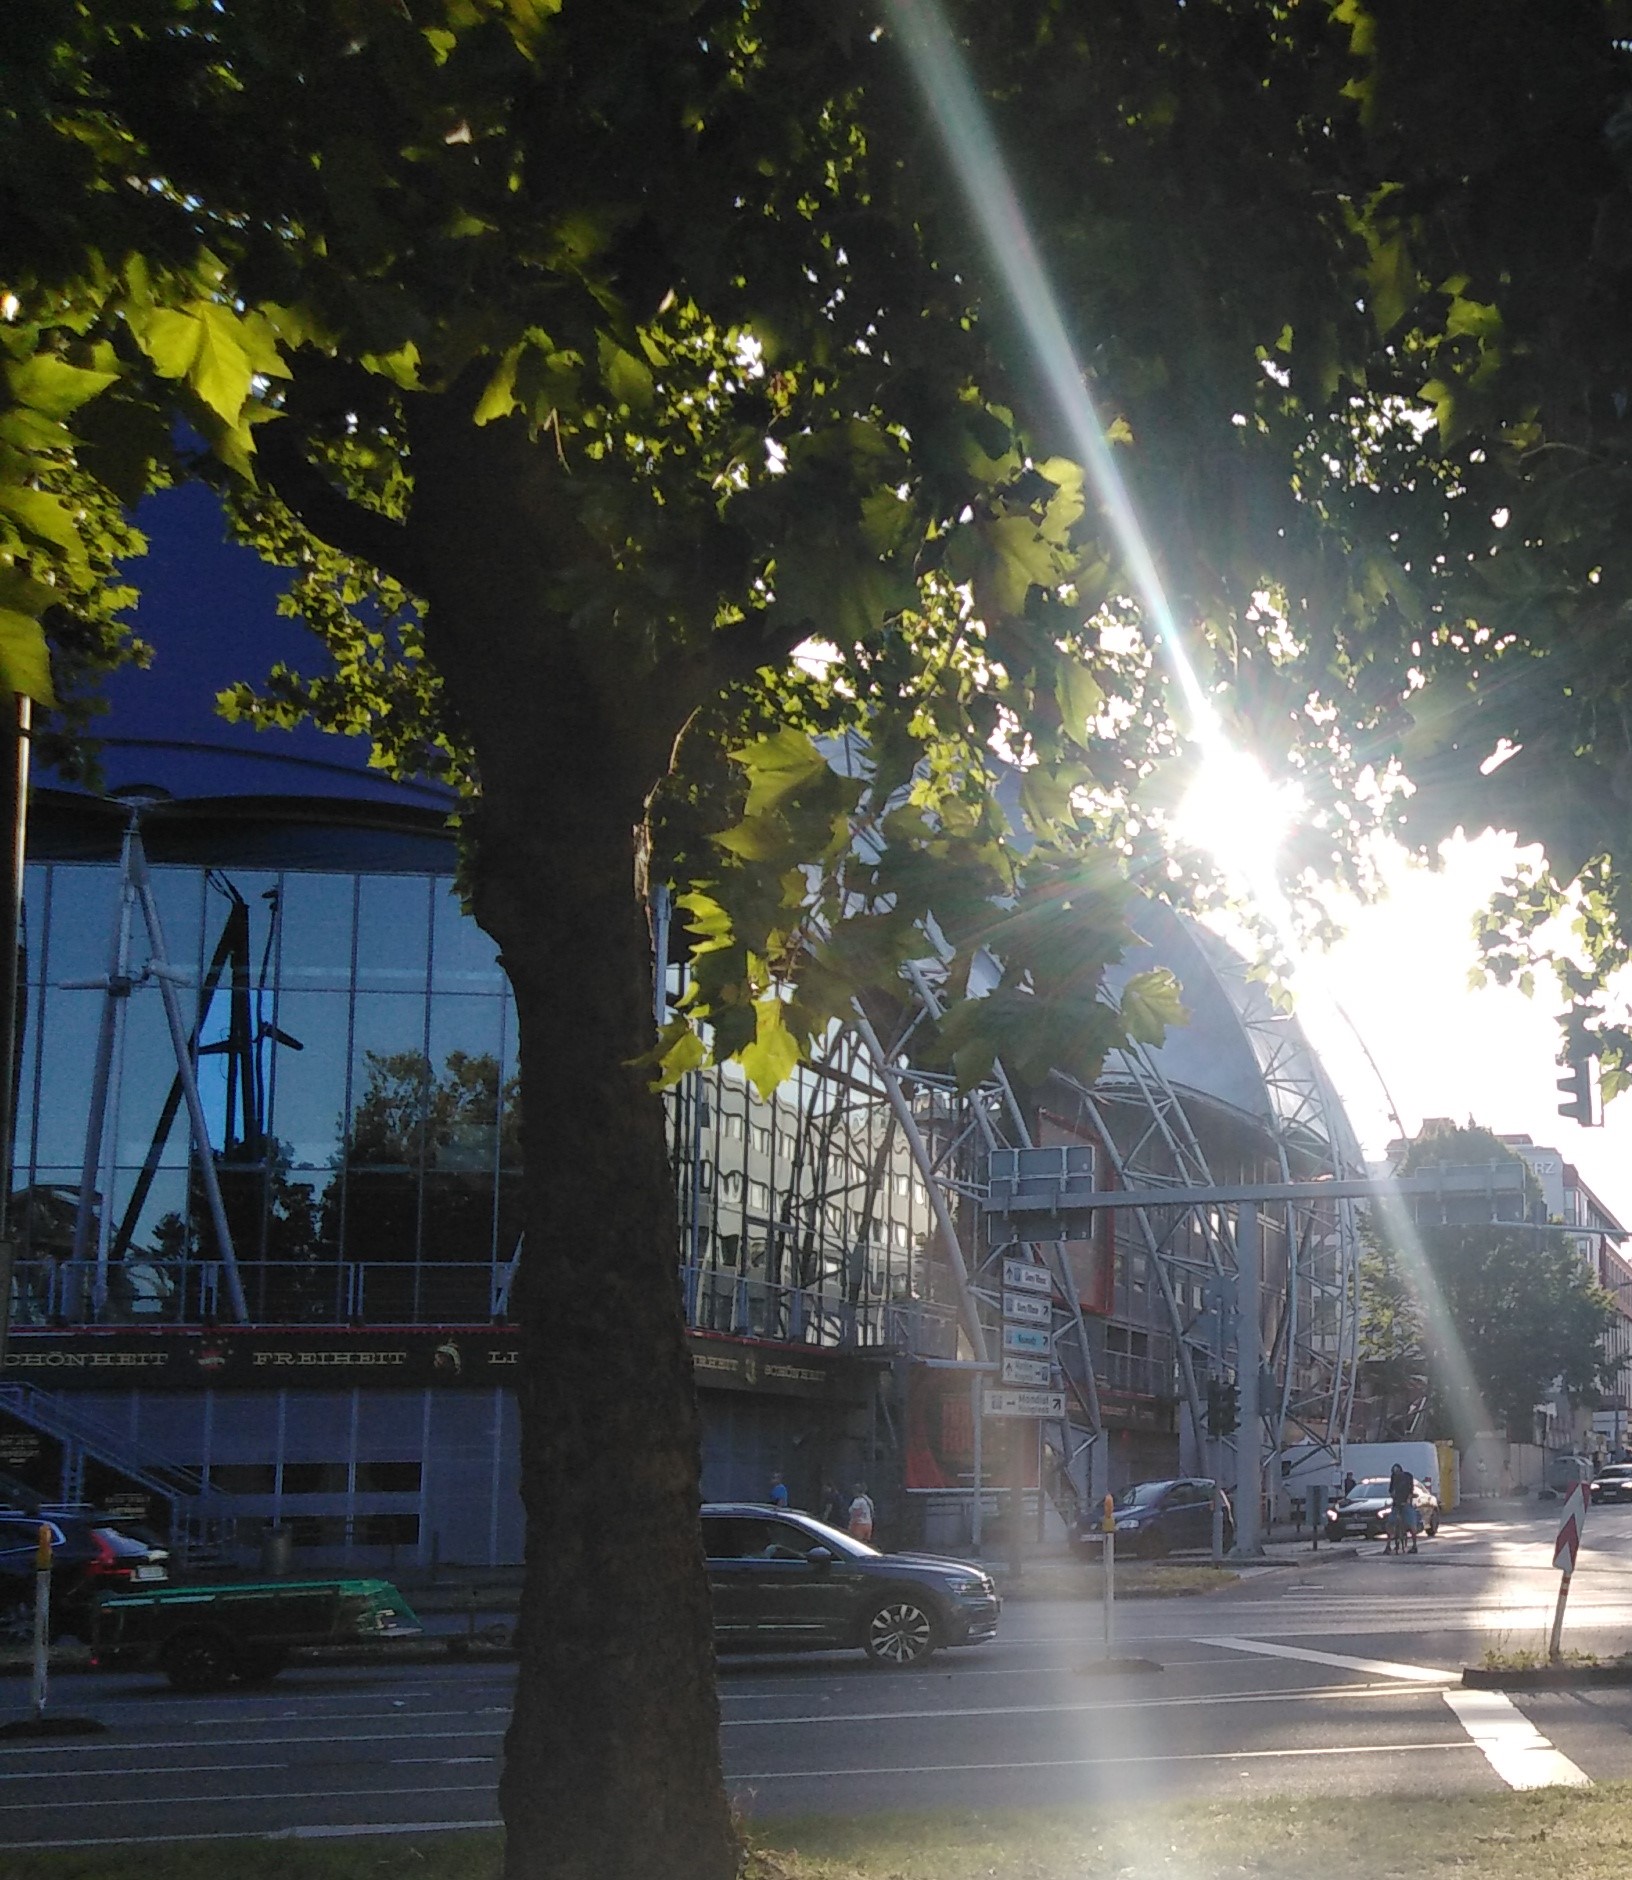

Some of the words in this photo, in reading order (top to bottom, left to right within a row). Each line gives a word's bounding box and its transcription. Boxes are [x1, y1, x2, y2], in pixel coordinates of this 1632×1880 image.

[1534, 1161, 1555, 1175] RZ
[4, 1351, 169, 1367] CHÖNHEIT
[252, 1351, 407, 1366] FREIHEIT
[487, 1351, 519, 1364] LI
[692, 1354, 739, 1371] RHEIT
